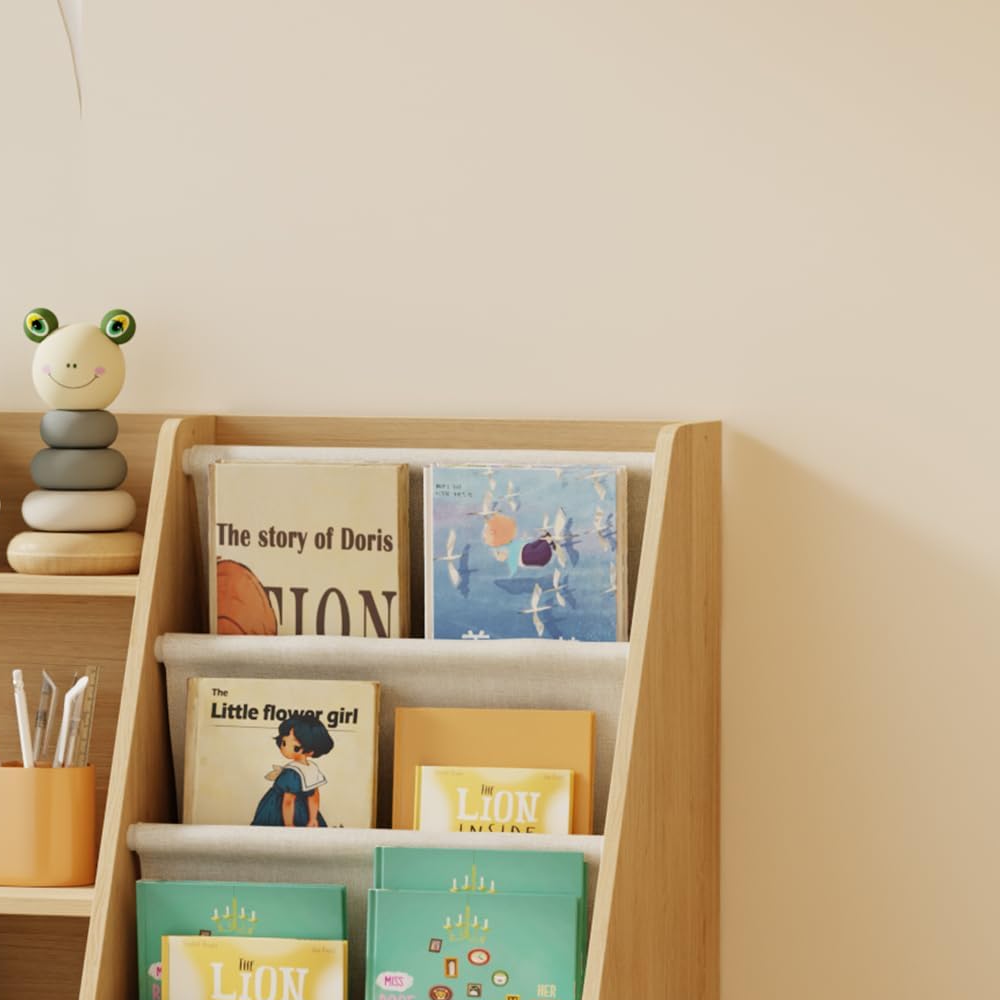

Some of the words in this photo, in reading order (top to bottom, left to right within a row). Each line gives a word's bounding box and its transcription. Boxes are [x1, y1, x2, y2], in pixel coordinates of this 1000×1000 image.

[217, 523, 250, 547] The
[258, 526, 307, 554] story
[314, 526, 334, 549] of
[341, 527, 393, 552] Doris
[212, 688, 228, 697] The
[211, 702, 259, 721] Little
[327, 708, 358, 728] girl
[456, 787, 541, 823] LION
[384, 975, 405, 988] MISS
[536, 984, 557, 998] HER
